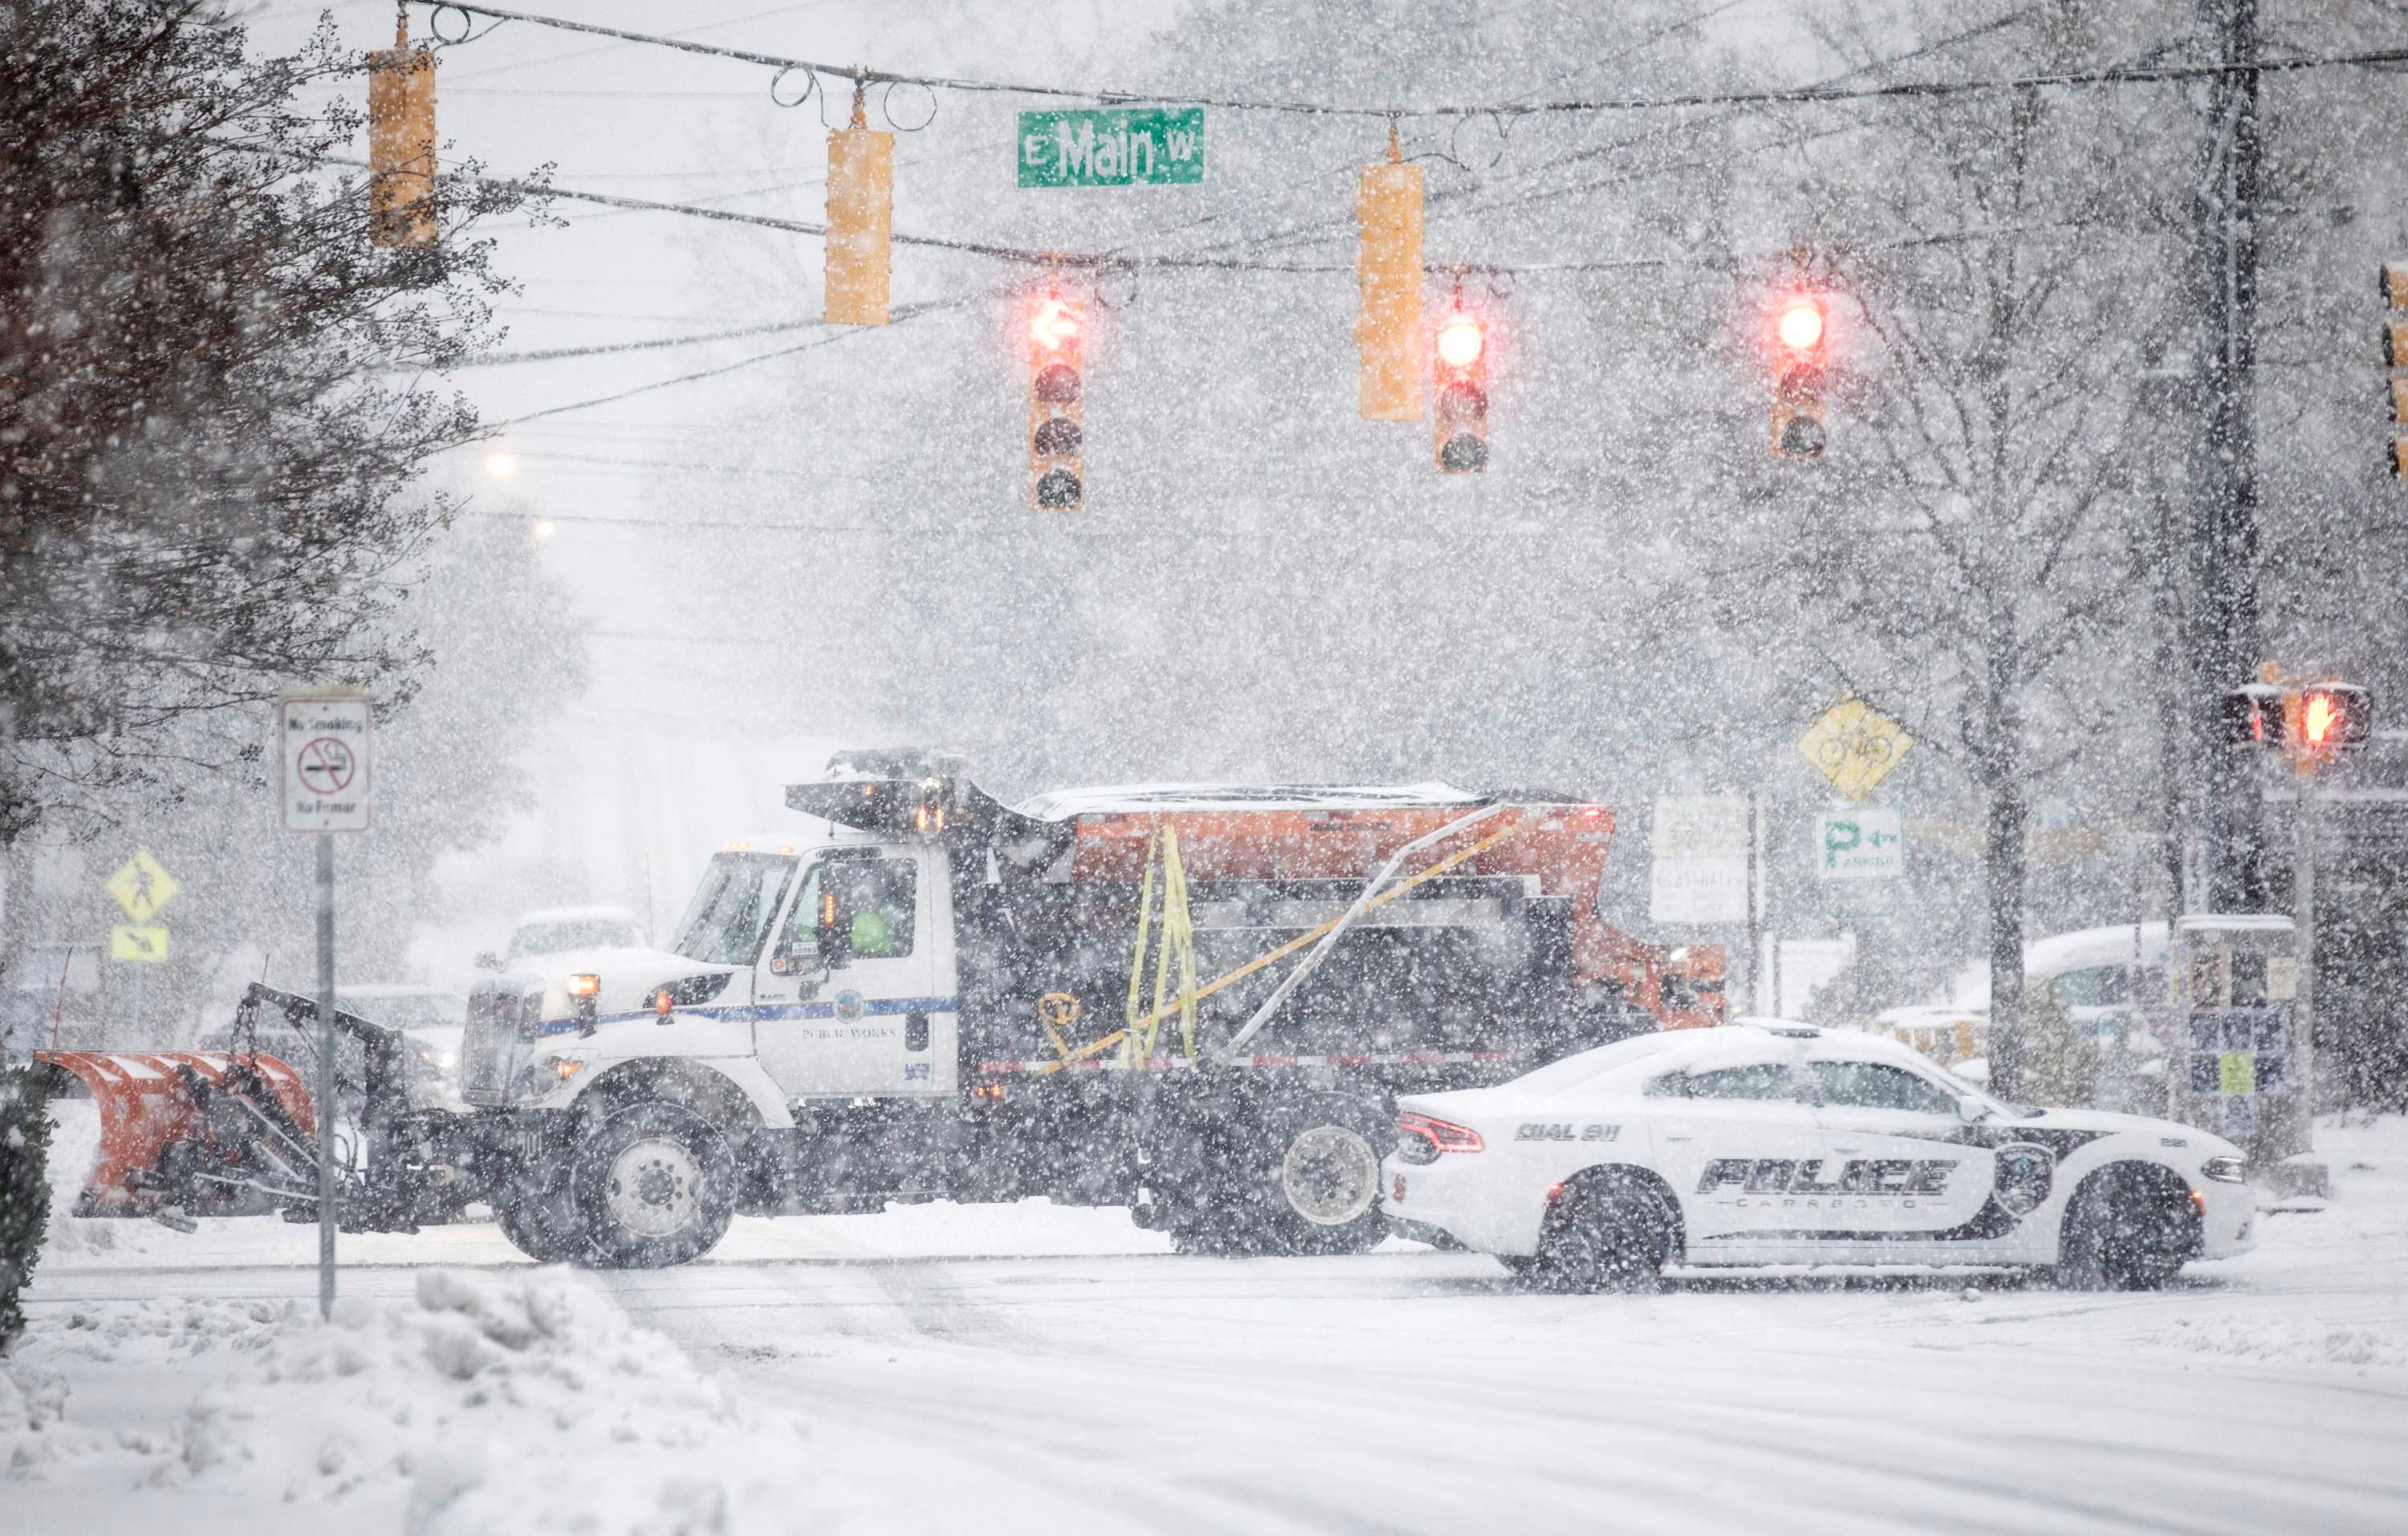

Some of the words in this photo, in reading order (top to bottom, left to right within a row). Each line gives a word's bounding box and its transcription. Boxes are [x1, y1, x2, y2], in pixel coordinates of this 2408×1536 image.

[1023, 135, 1047, 165] E
[1059, 119, 1153, 177] Main
[1167, 131, 1195, 161] W
[289, 718, 304, 730] No
[308, 717, 362, 733] Smoking
[851, 1028, 897, 1039] WORKS
[1694, 1158, 1961, 1196] POLICE
